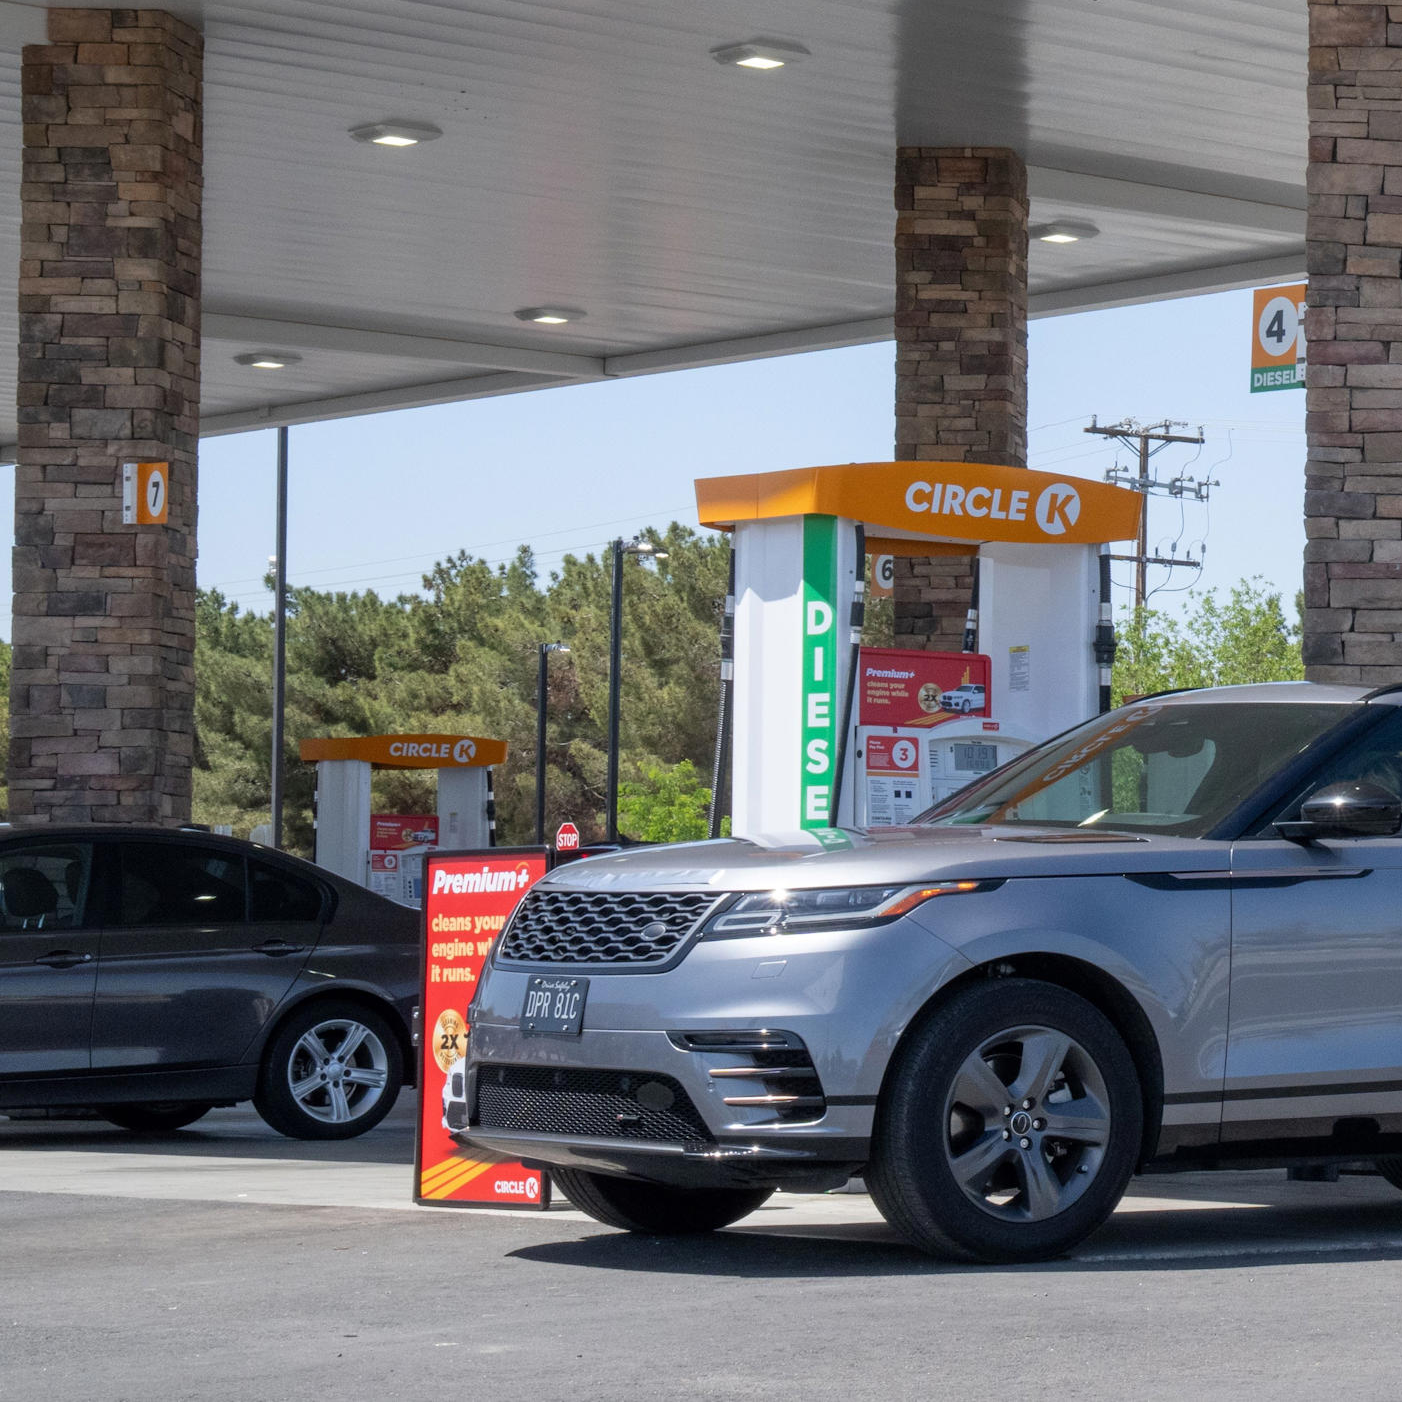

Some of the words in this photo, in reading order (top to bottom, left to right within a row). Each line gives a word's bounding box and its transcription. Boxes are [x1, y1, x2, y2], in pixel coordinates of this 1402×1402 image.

[1265, 309, 1286, 343] 4
[1254, 369, 1297, 388] DIESEL
[152, 481, 160, 508] 7
[905, 481, 1030, 521] CIRCLE
[881, 558, 894, 581] 6
[805, 600, 833, 820] DIESE
[389, 742, 451, 758] CIRCLE
[899, 747, 909, 762] 3
[558, 833, 577, 847] STOP
[432, 866, 529, 895] Premium+
[432, 913, 472, 932] cleans
[474, 915, 506, 934] your
[432, 938, 474, 960] engine
[431, 965, 441, 982] it
[443, 966, 476, 982] runs.
[525, 990, 551, 1018] DPR
[554, 992, 580, 1019] 81C
[440, 1034, 459, 1050] 2X
[494, 1180, 525, 1194] CIRCLE
